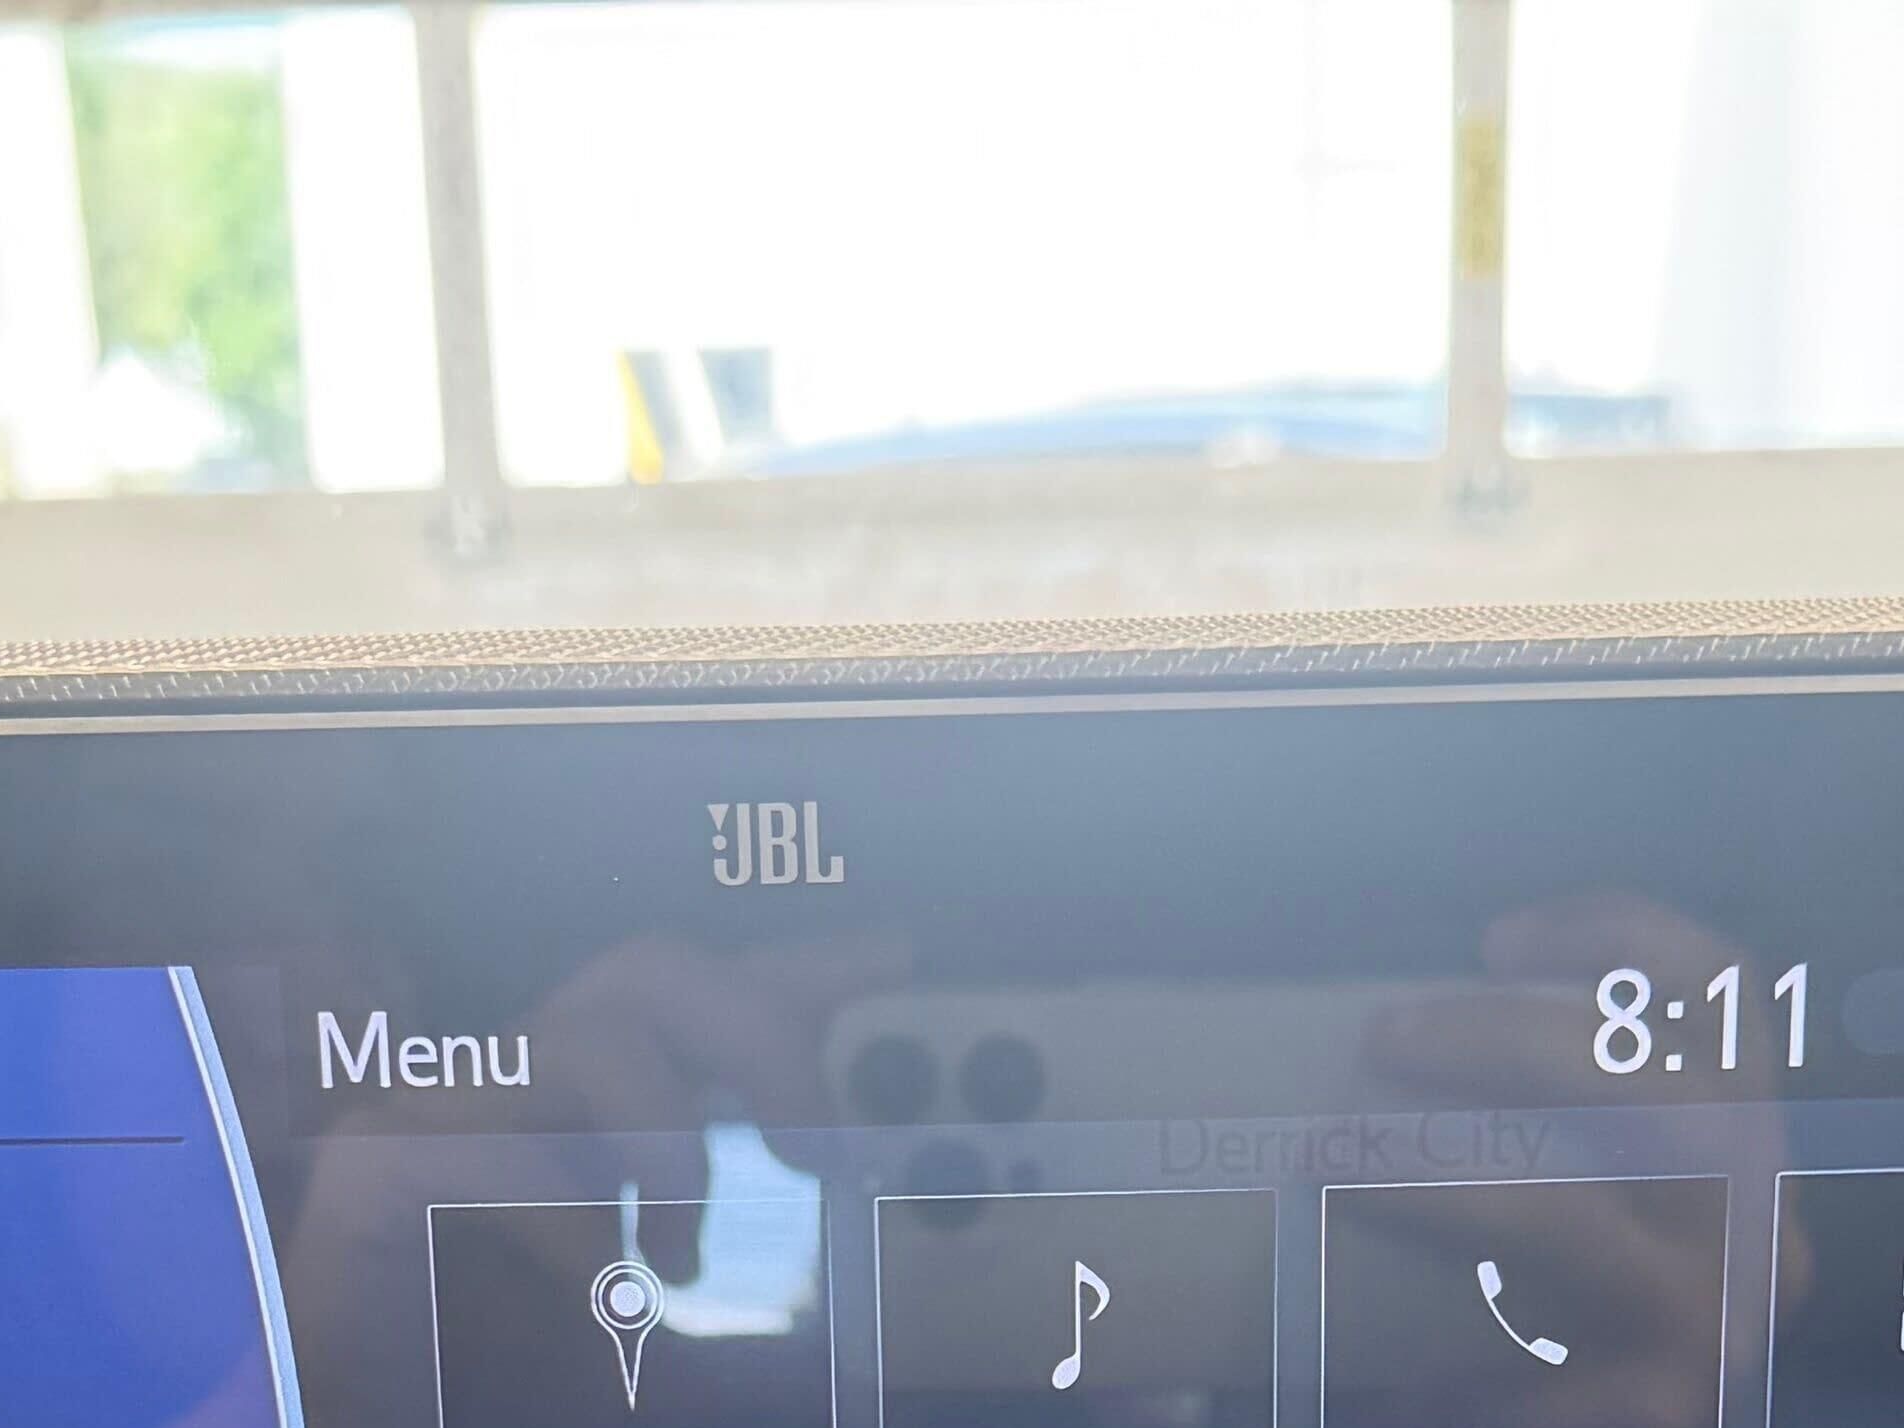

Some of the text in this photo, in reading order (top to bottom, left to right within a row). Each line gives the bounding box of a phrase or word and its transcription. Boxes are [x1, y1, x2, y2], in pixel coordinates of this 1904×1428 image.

[707, 800, 845, 887] JBL
[315, 1009, 534, 1093] Menu
[1593, 961, 1809, 1074] 8:11
[1159, 1106, 1555, 1180] Derrick City
